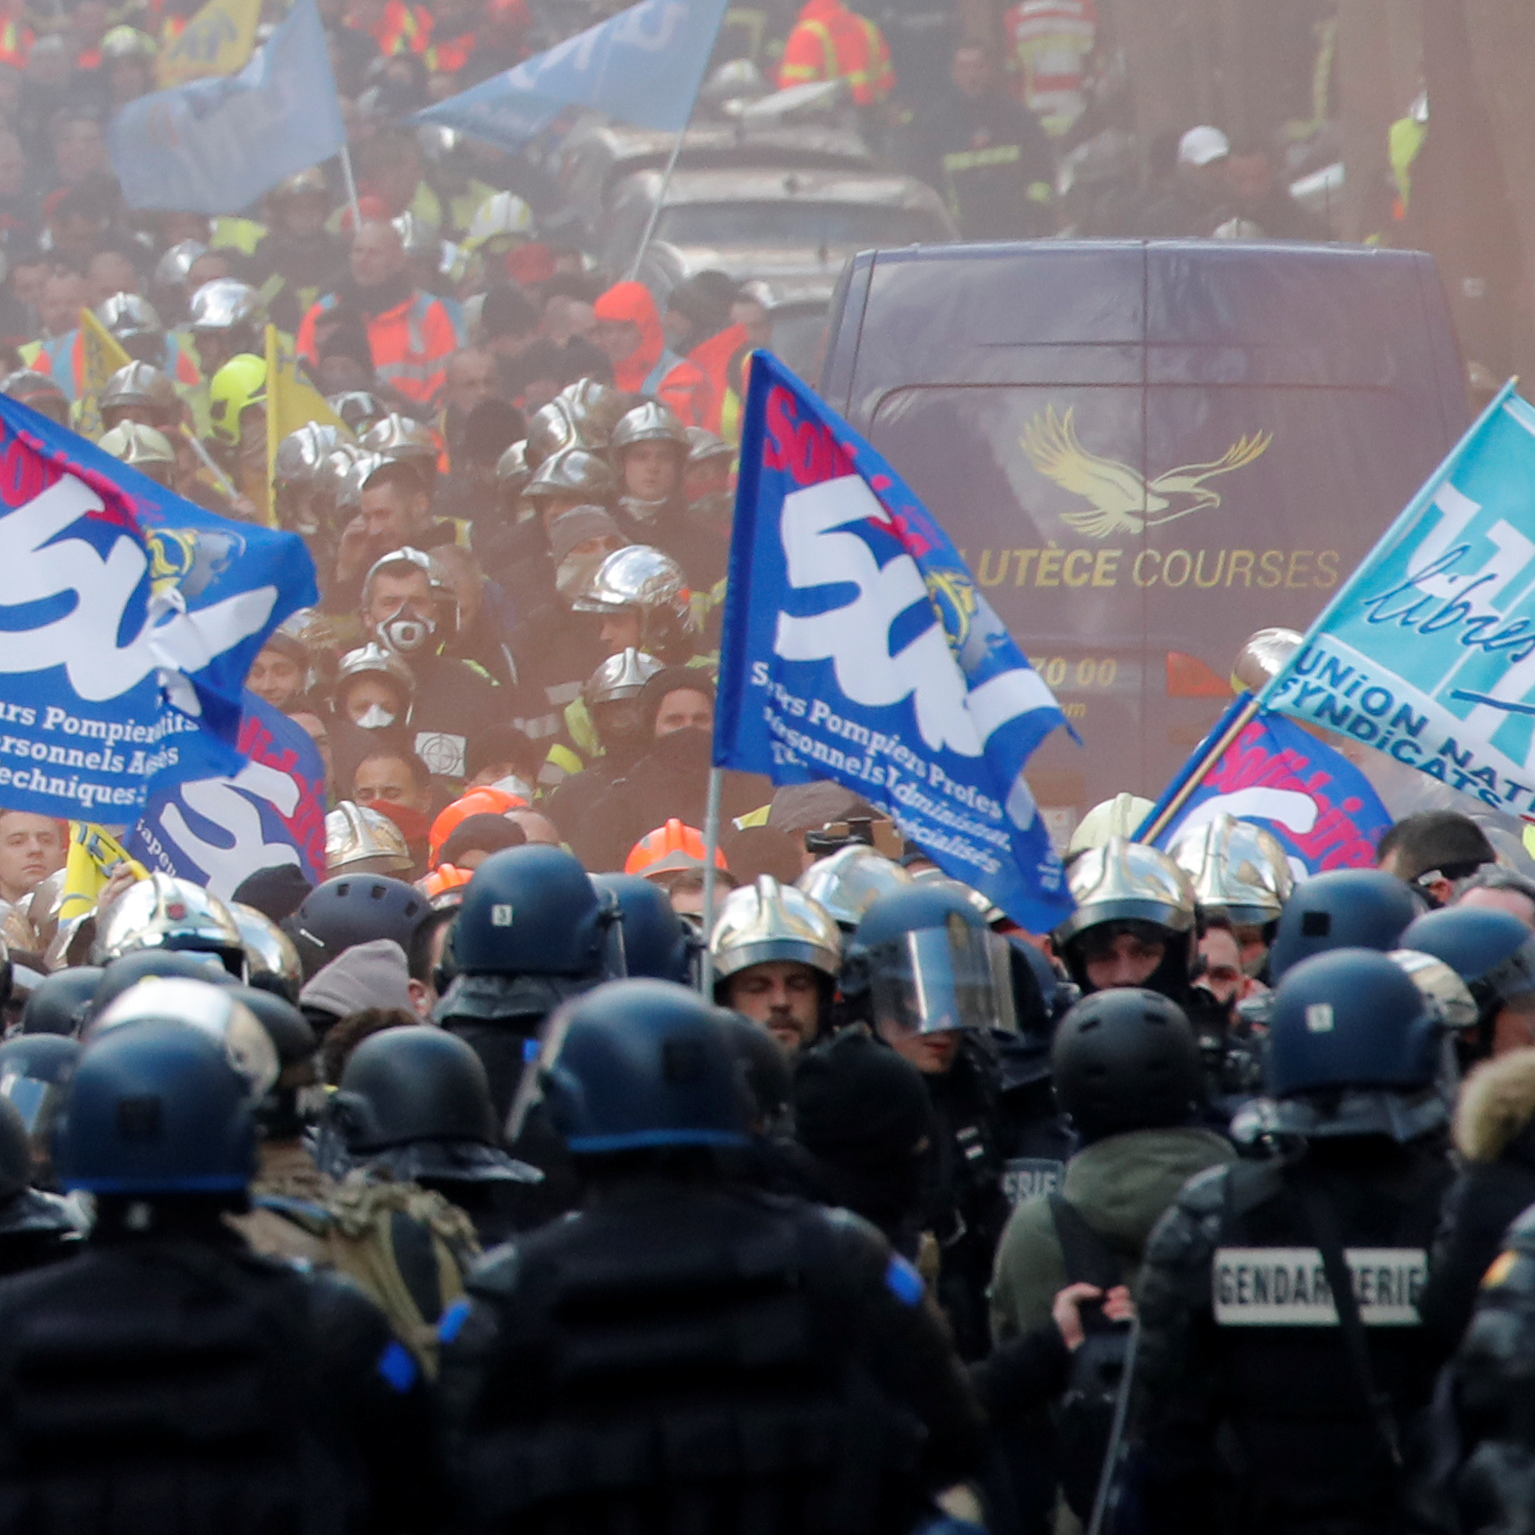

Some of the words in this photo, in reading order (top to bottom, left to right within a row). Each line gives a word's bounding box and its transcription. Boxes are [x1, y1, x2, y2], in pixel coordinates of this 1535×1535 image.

[961, 540, 1123, 588] UTÈCE
[1132, 549, 1342, 588] COURSES
[42, 706, 159, 747] Pompier
[1216, 1265, 1426, 1307] GENDARERIE
